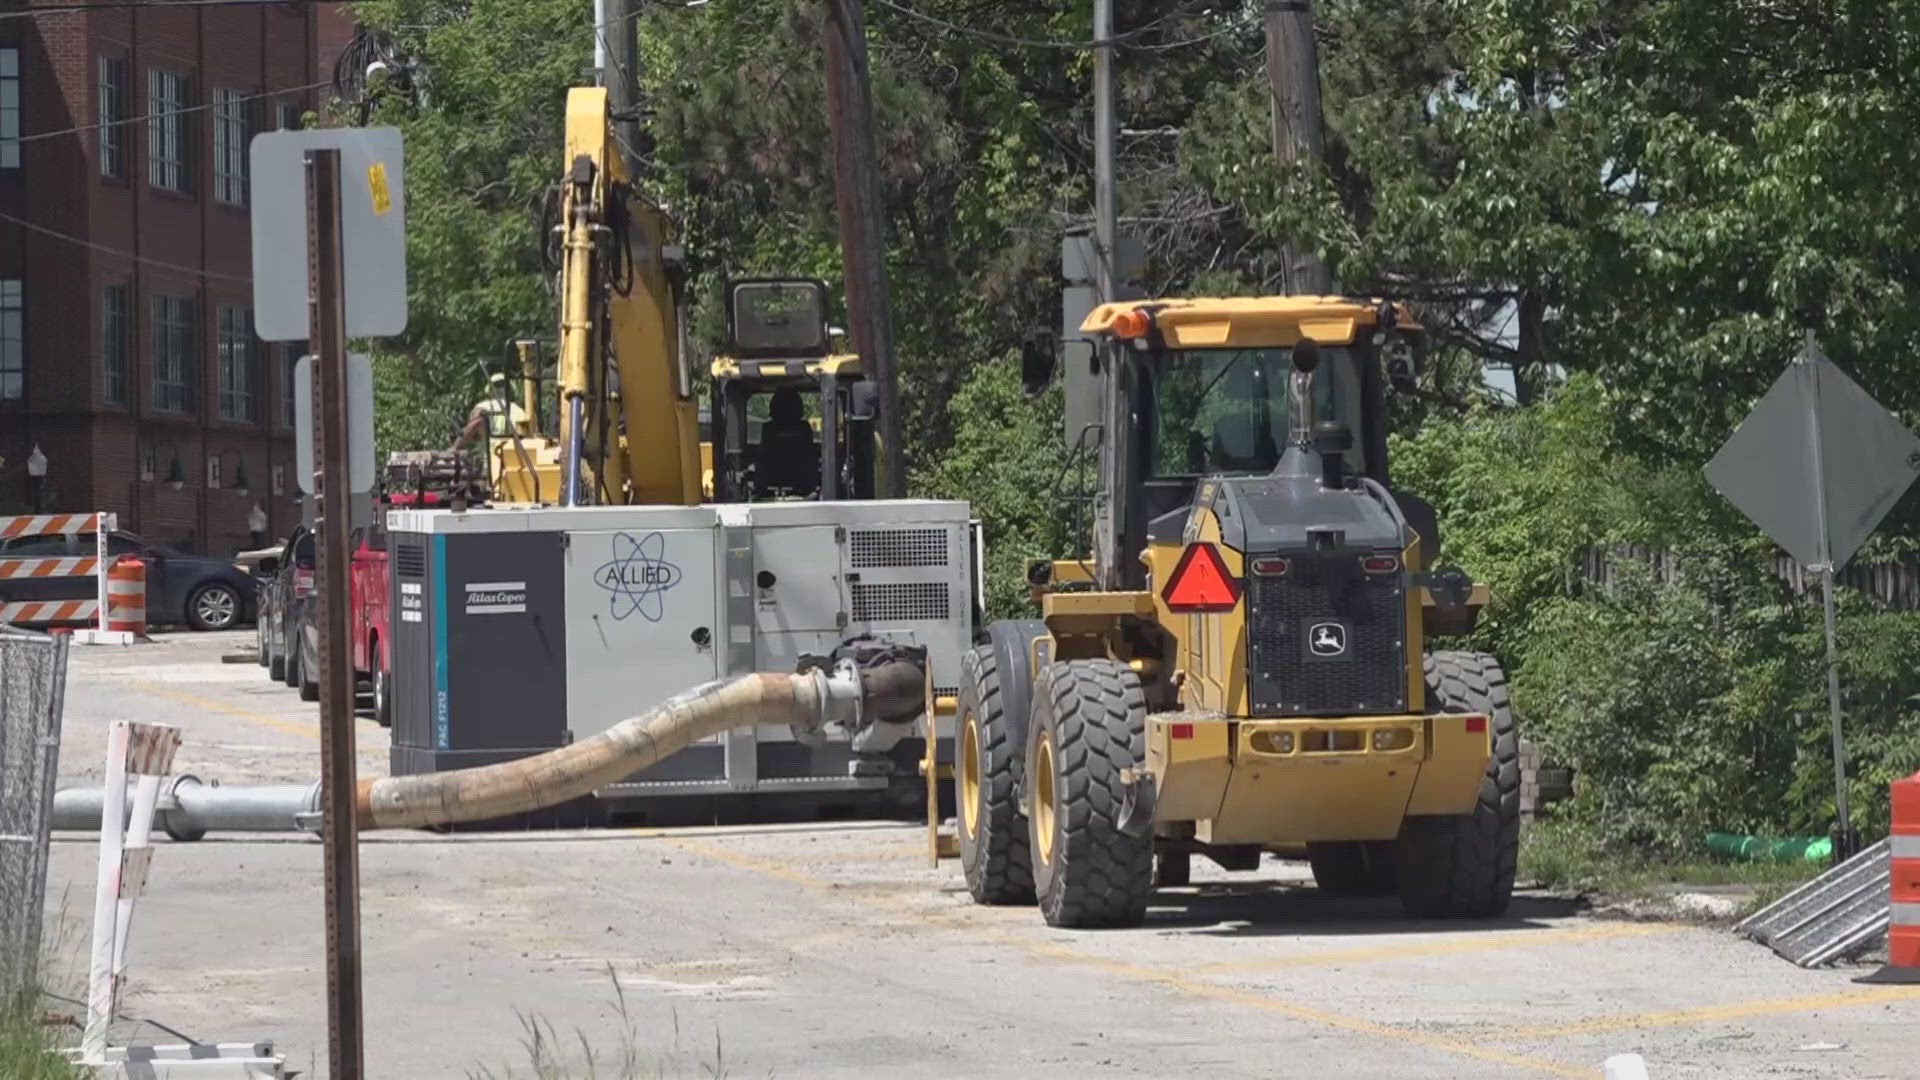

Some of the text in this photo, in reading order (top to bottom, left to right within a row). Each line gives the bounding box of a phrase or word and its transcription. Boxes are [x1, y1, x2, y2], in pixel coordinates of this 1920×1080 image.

[605, 566, 671, 585] ALLIED
[466, 591, 526, 604] Atlas Copco
[438, 723, 447, 747] PAC
